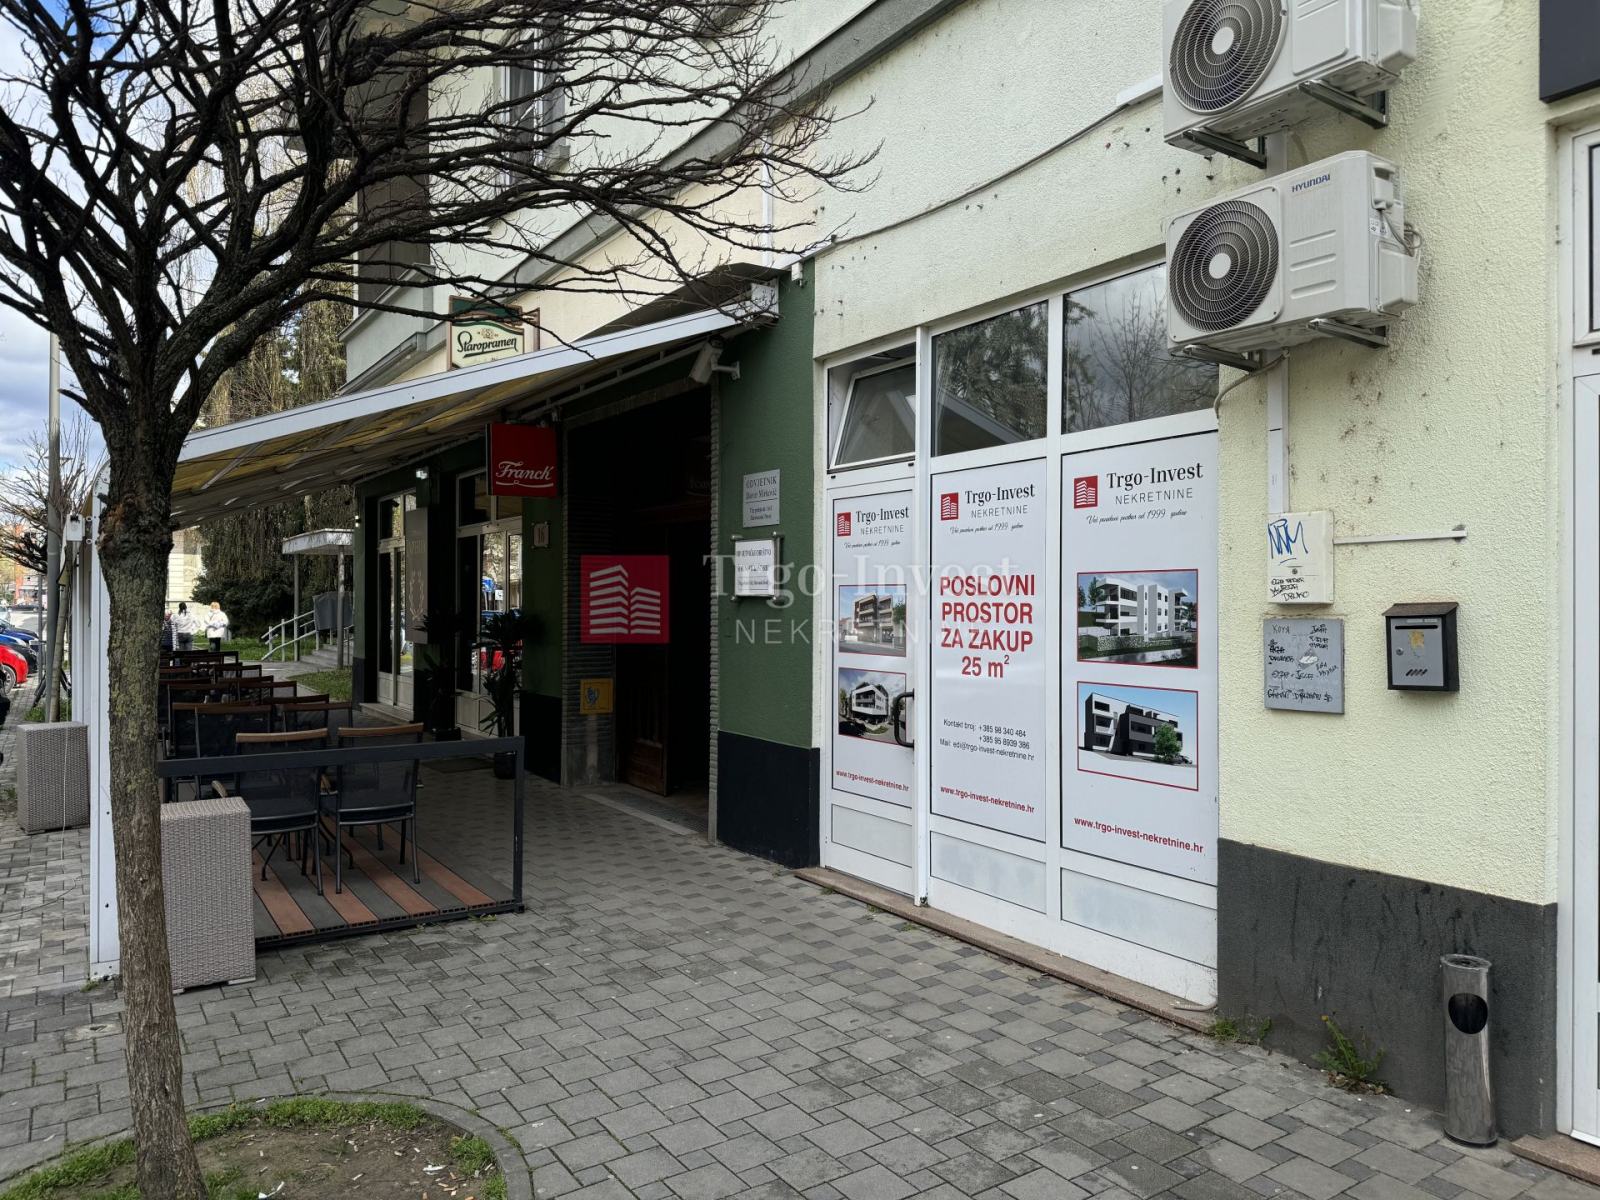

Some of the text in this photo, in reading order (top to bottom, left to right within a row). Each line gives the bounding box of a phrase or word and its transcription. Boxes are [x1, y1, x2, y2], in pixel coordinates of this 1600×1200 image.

[1291, 174, 1331, 192] HYUNDAI
[457, 330, 519, 353] Staropramen
[495, 461, 554, 481] Franck
[1106, 462, 1204, 492] Trgo-Invest
[964, 483, 1036, 507] Trgo-Invest
[1115, 487, 1194, 505] NEKRETNINE
[856, 506, 910, 526] Trgo-Invest
[971, 504, 1029, 519] NEKRETNINE
[861, 524, 905, 535] NEKRETNINE
[940, 574, 1035, 597] POSLOVNI
[941, 601, 1033, 624] PROSTOR
[941, 627, 1033, 653] ZA ZAKUP
[961, 655, 982, 677] 25
[943, 719, 963, 729] Kontakt
[979, 724, 993, 734] +385
[1003, 728, 1014, 736] 340
[1015, 729, 1026, 738] 484
[979, 735, 993, 744] +385
[836, 770, 909, 791] www.trgo-invest-nekretnine.hr
[940, 785, 1035, 814] www.trgo-invest-nekretnine.hr
[1073, 817, 1204, 853] www.trgo-invest-nekretnine.hr
